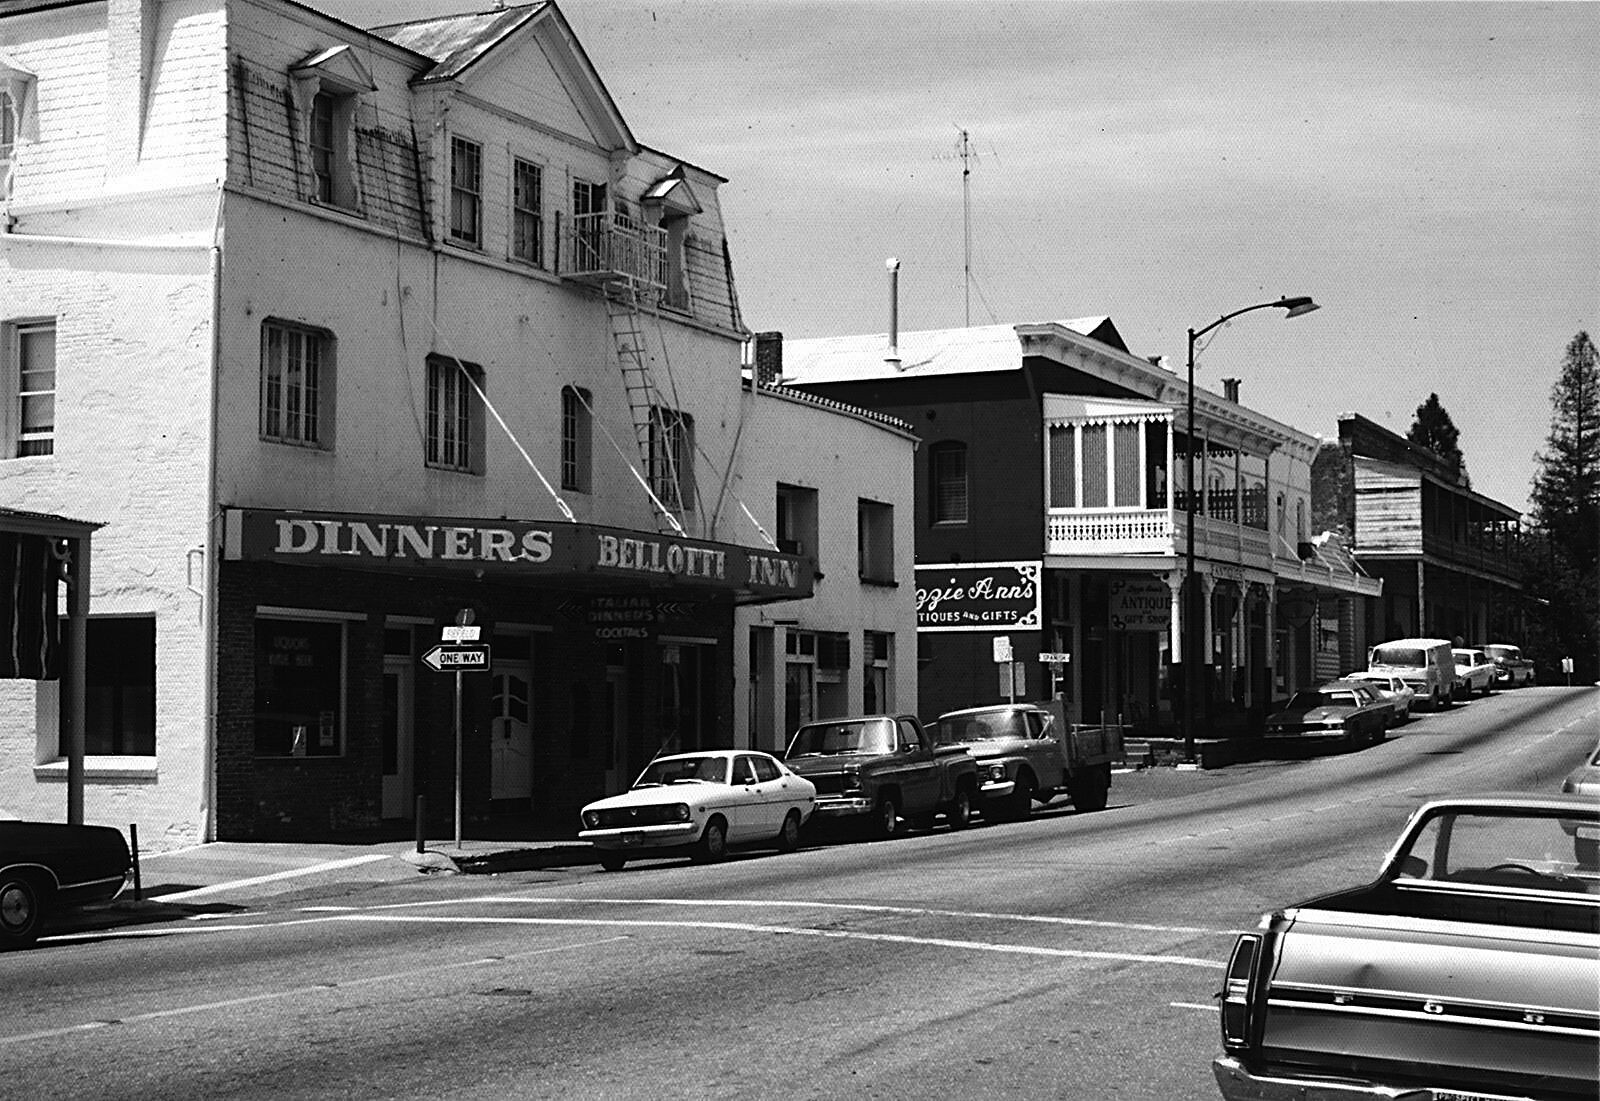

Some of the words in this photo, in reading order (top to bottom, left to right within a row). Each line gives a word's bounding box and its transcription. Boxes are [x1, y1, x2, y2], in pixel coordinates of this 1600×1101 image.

[275, 519, 553, 562] DINNERS
[598, 535, 725, 579] BELLOTTI
[748, 555, 798, 588] INN
[968, 577, 1033, 599] Ann's
[590, 596, 651, 609] ITALIAN
[588, 610, 655, 623] DINNERS
[981, 610, 1017, 621] GIFTS
[1124, 615, 1143, 624] GIFT
[1147, 615, 1169, 625] SHOP
[595, 626, 649, 639] COCKTAILS
[440, 653, 459, 664] ONE
[463, 653, 482, 664] WAY
